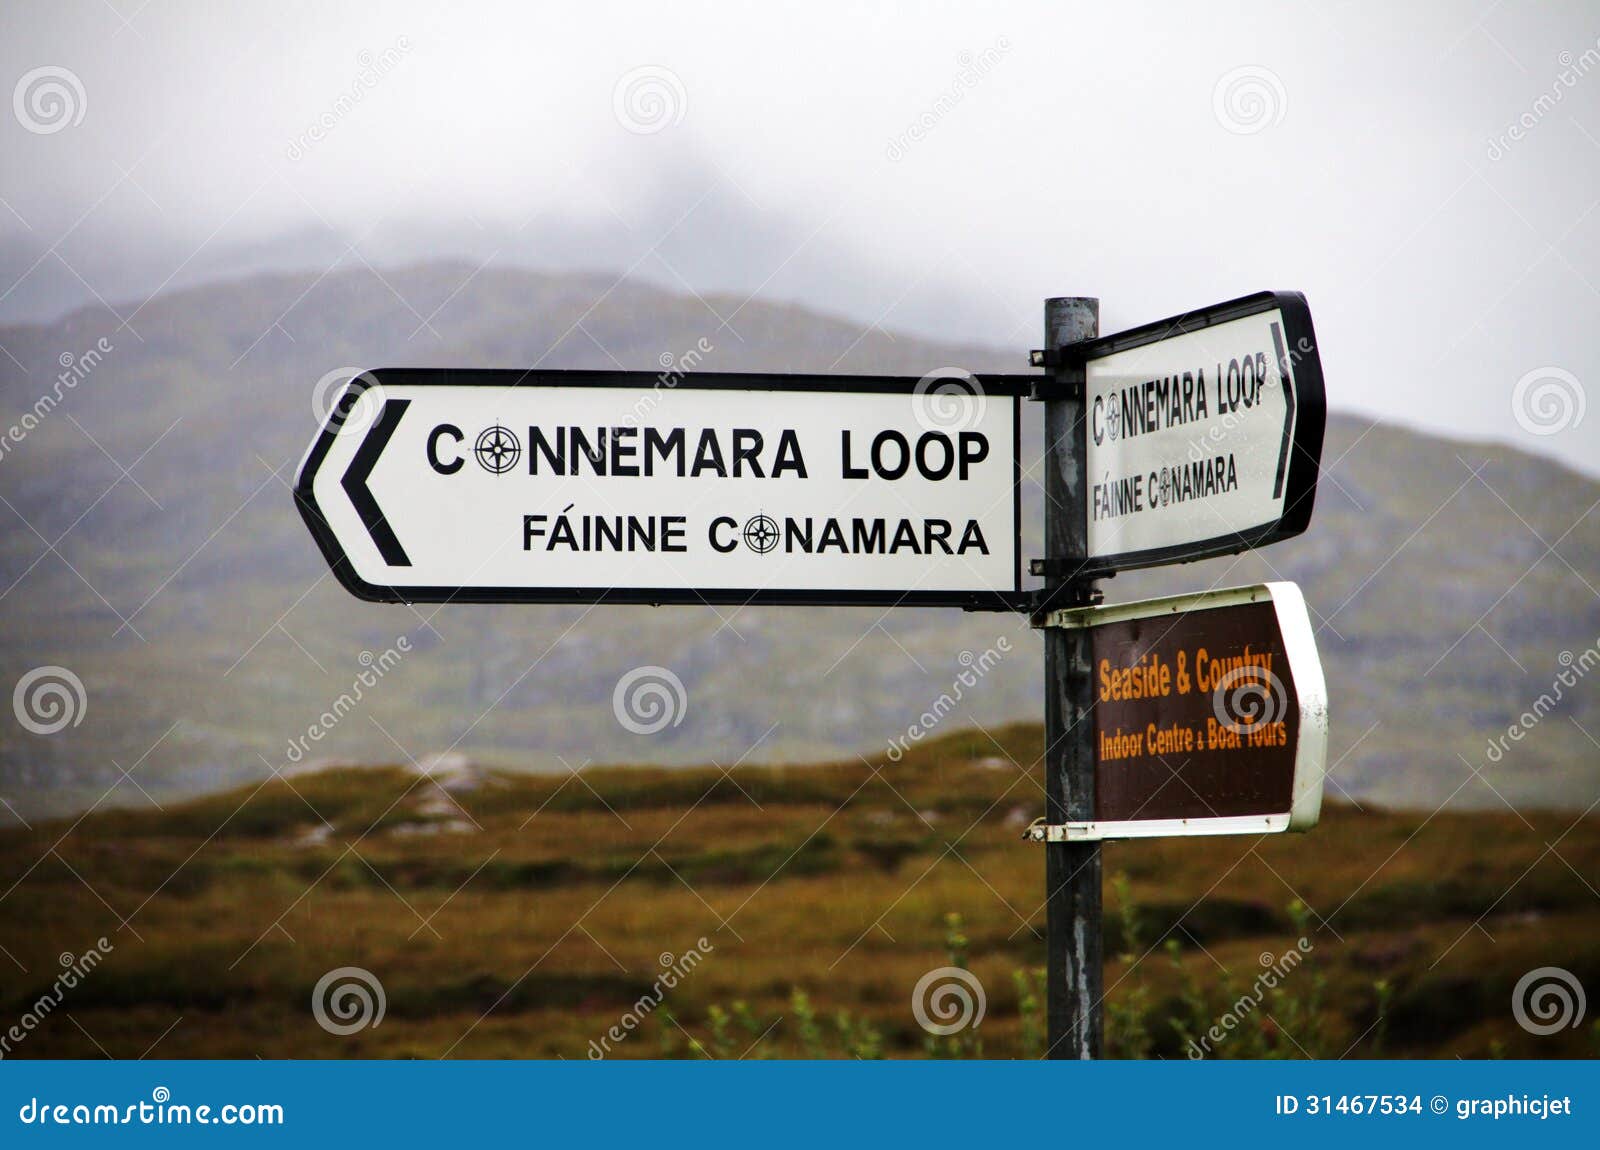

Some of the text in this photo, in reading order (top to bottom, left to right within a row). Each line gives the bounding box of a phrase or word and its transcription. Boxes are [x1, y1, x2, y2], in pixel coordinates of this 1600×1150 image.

[1092, 351, 1268, 447] CONNEMARA LOOP
[426, 422, 990, 482] CONNEMARA LOOP
[1093, 453, 1238, 522] FÁINNE CONAMARA
[523, 503, 991, 556] FÁINNE CONAMARA
[1099, 645, 1273, 703] Seaside & Country
[1100, 727, 1144, 762] Indoor
[1146, 722, 1194, 757] Centre
[1207, 716, 1243, 751] Boat
[1243, 713, 1288, 747] Tours
